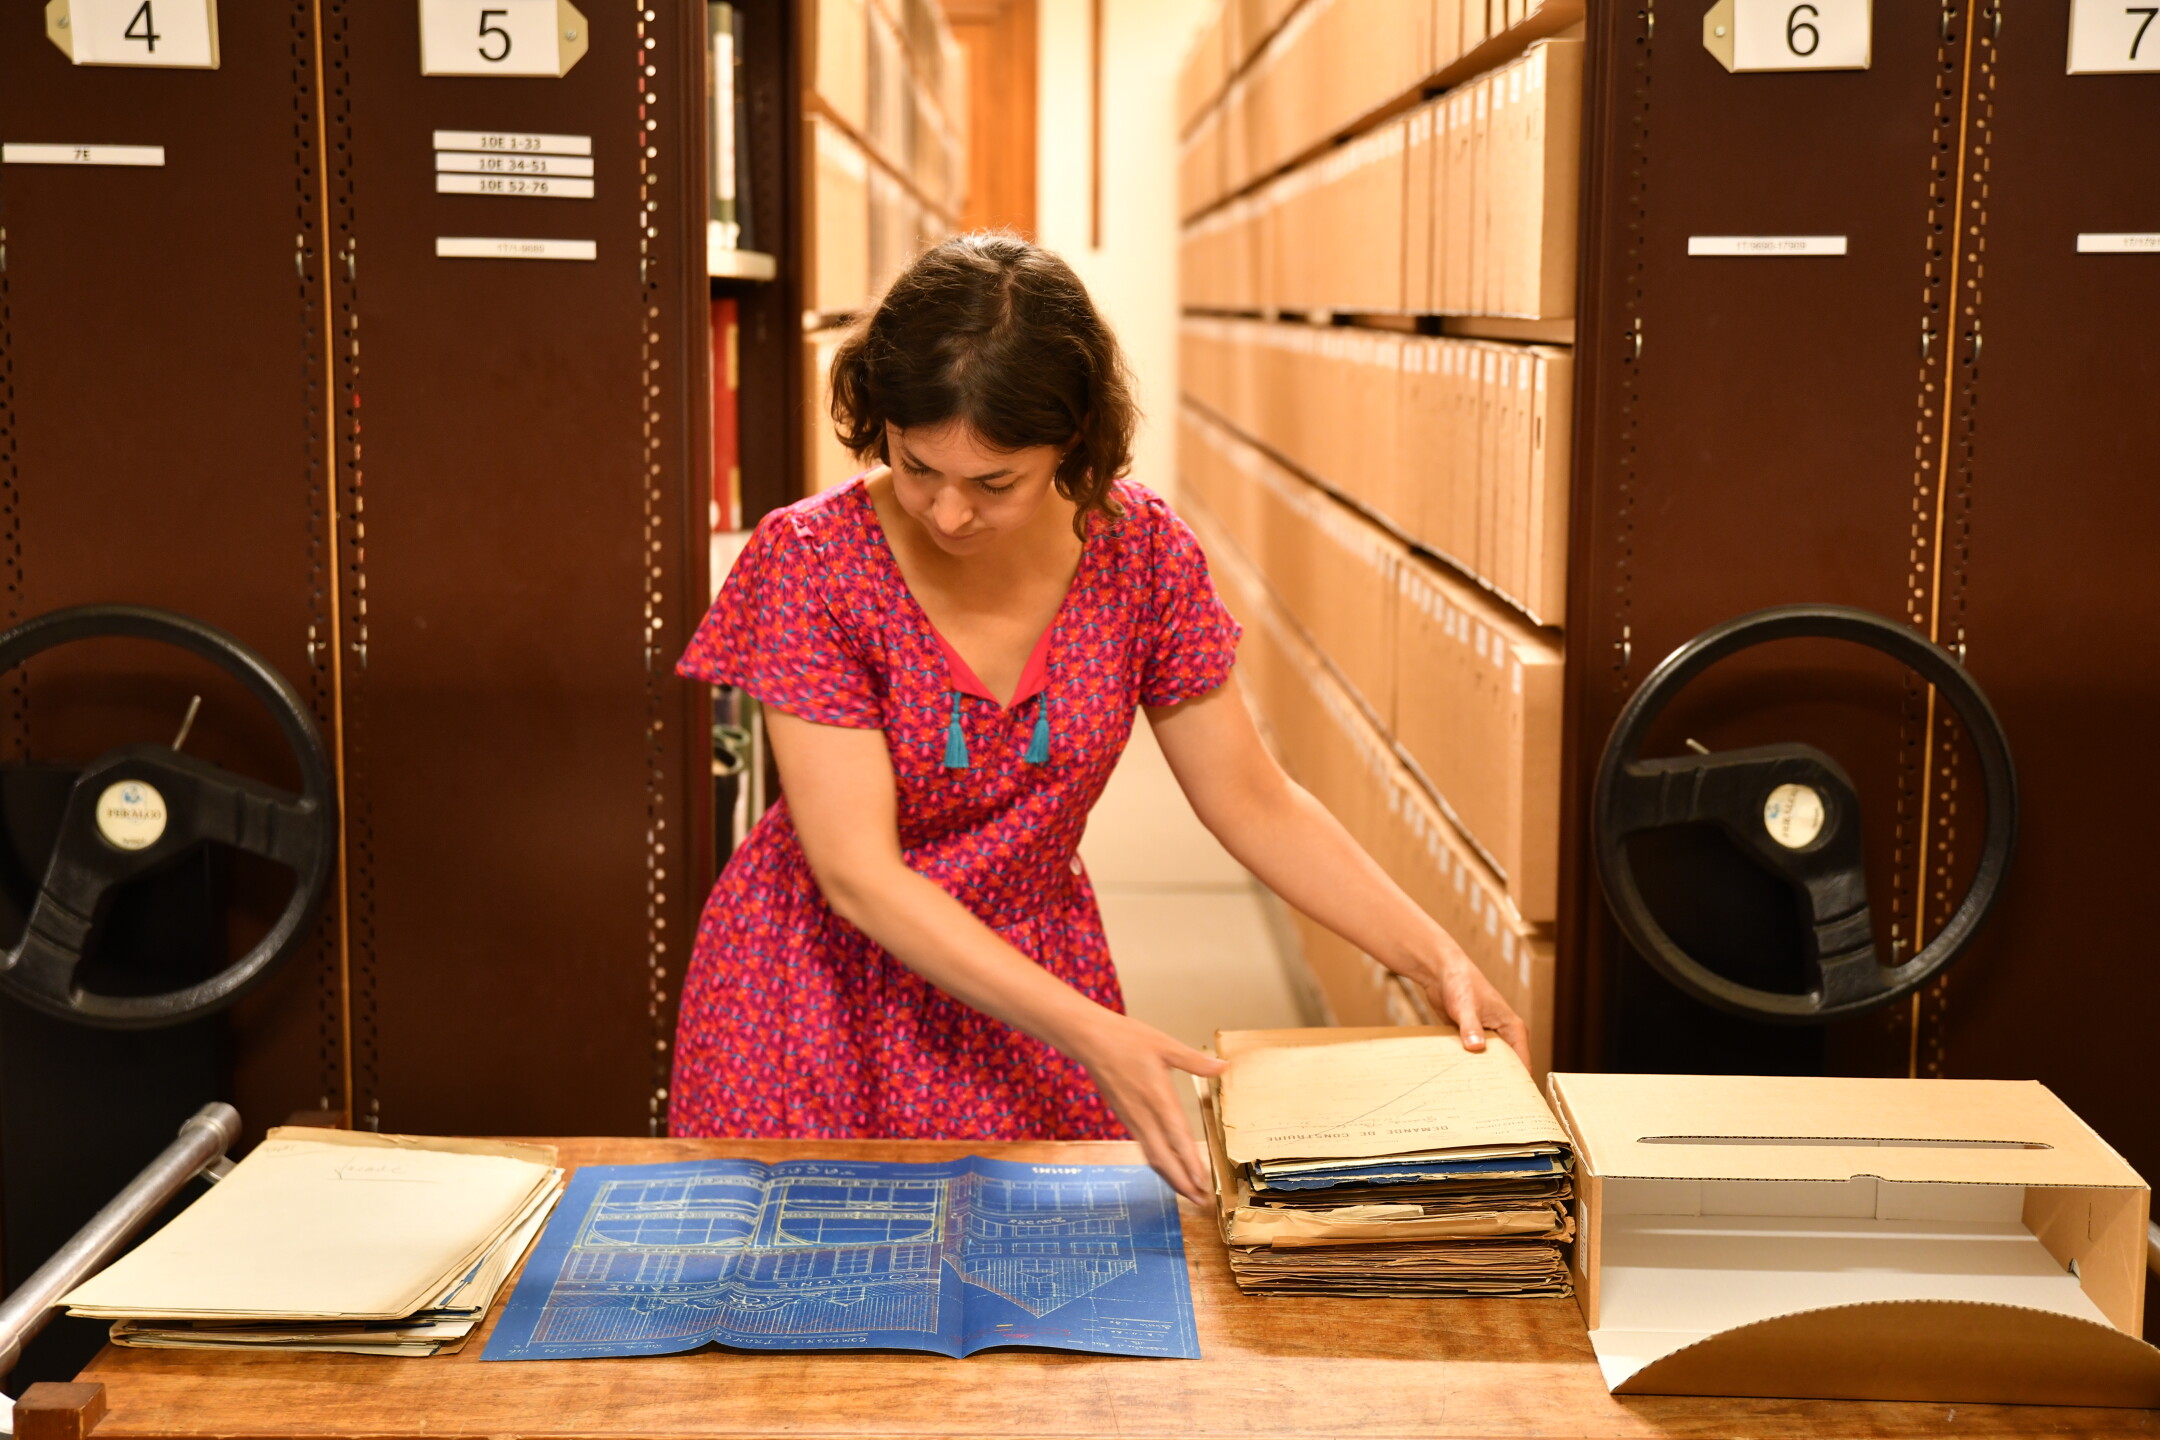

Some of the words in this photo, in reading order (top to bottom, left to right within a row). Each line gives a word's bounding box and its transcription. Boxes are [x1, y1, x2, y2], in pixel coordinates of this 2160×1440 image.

[124, 0, 161, 54] 4
[1786, 4, 1820, 57] 6
[2126, 7, 2160, 60] 7
[477, 9, 512, 63] 5
[480, 136, 504, 149] 10E
[511, 138, 542, 150] 1-33
[72, 147, 92, 162] 7E
[479, 158, 503, 171] 10E
[509, 160, 548, 172] 34-51
[480, 179, 503, 192] 10E
[509, 181, 549, 193] 52-76
[1265, 1132, 1350, 1143] CONSTRUIRE
[1385, 1125, 1449, 1136] DEMANDE
